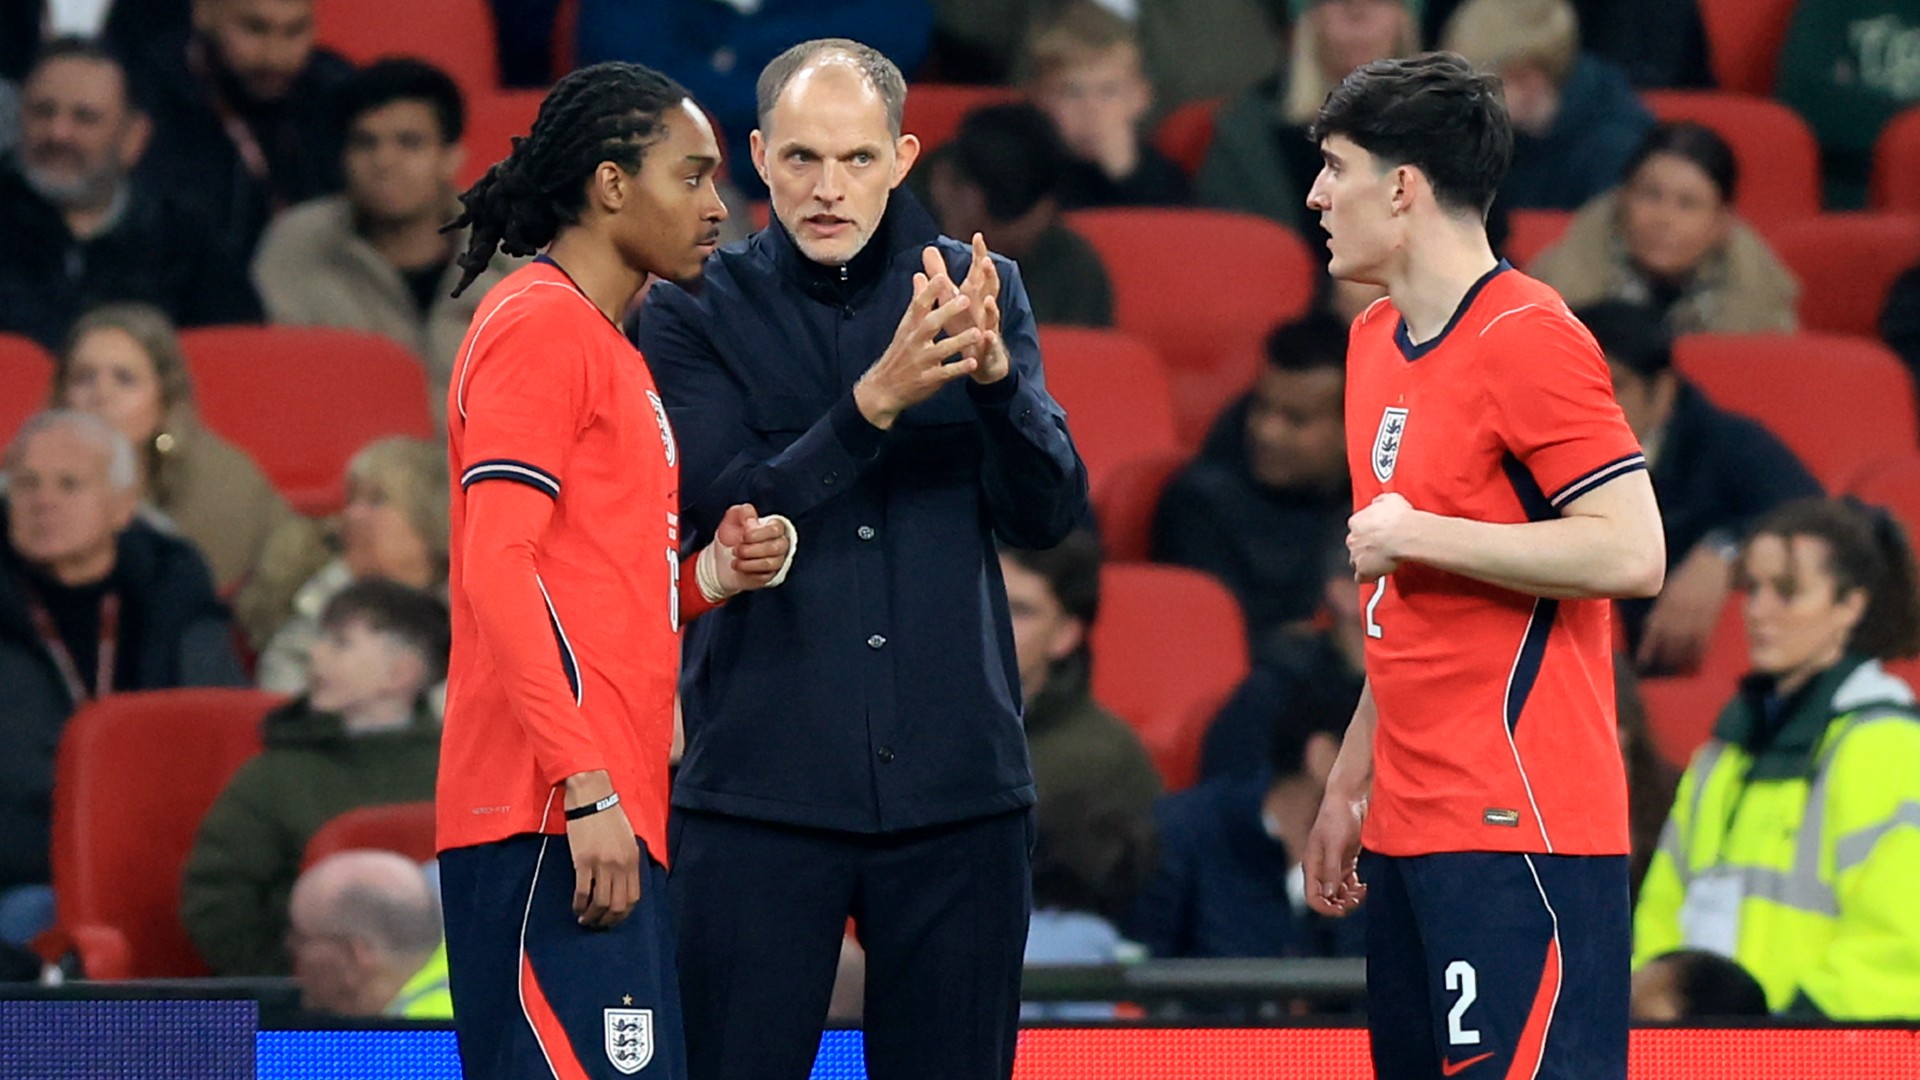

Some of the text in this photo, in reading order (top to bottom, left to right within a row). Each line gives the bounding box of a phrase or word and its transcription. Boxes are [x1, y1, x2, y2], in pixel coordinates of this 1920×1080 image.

[666, 545, 680, 633] 6
[1366, 575, 1386, 639] 2
[1445, 960, 1481, 1045] 2
